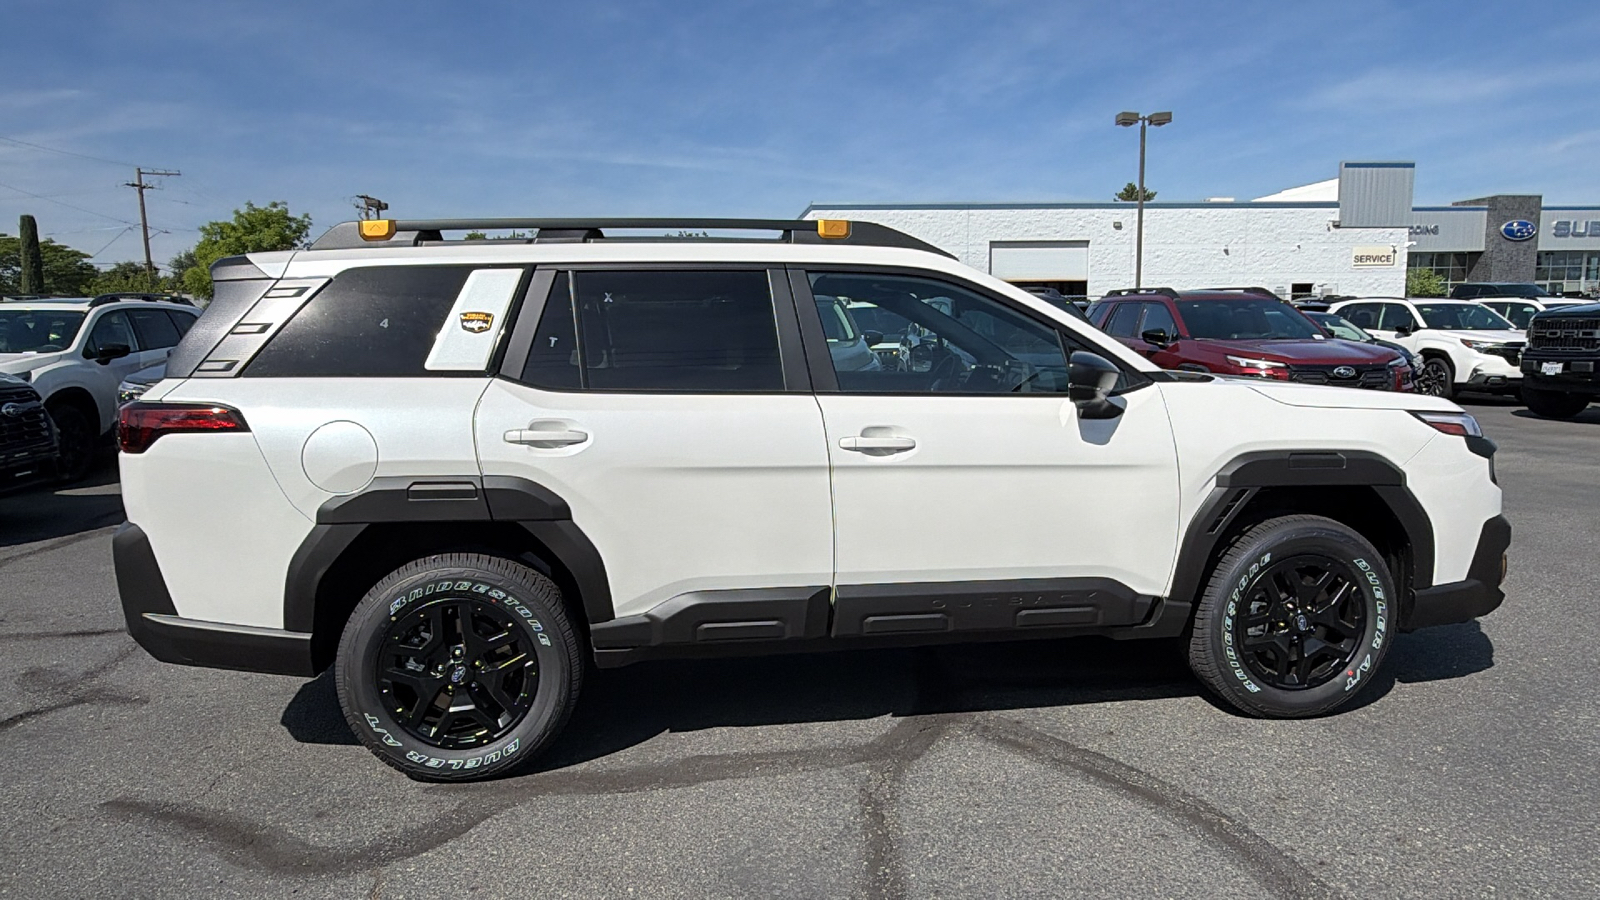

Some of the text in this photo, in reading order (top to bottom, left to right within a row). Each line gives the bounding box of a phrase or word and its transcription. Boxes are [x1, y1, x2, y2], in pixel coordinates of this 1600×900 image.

[1353, 254, 1392, 264] SERVICE
[379, 318, 389, 329] 4
[1532, 329, 1600, 339] FORD
[549, 336, 558, 348] T
[389, 581, 551, 647] BRIDGESTONE
[1224, 552, 1271, 694] BRIDGESTONE
[1345, 558, 1387, 692] DUELER A/T
[364, 712, 520, 770] DUELER A/T
